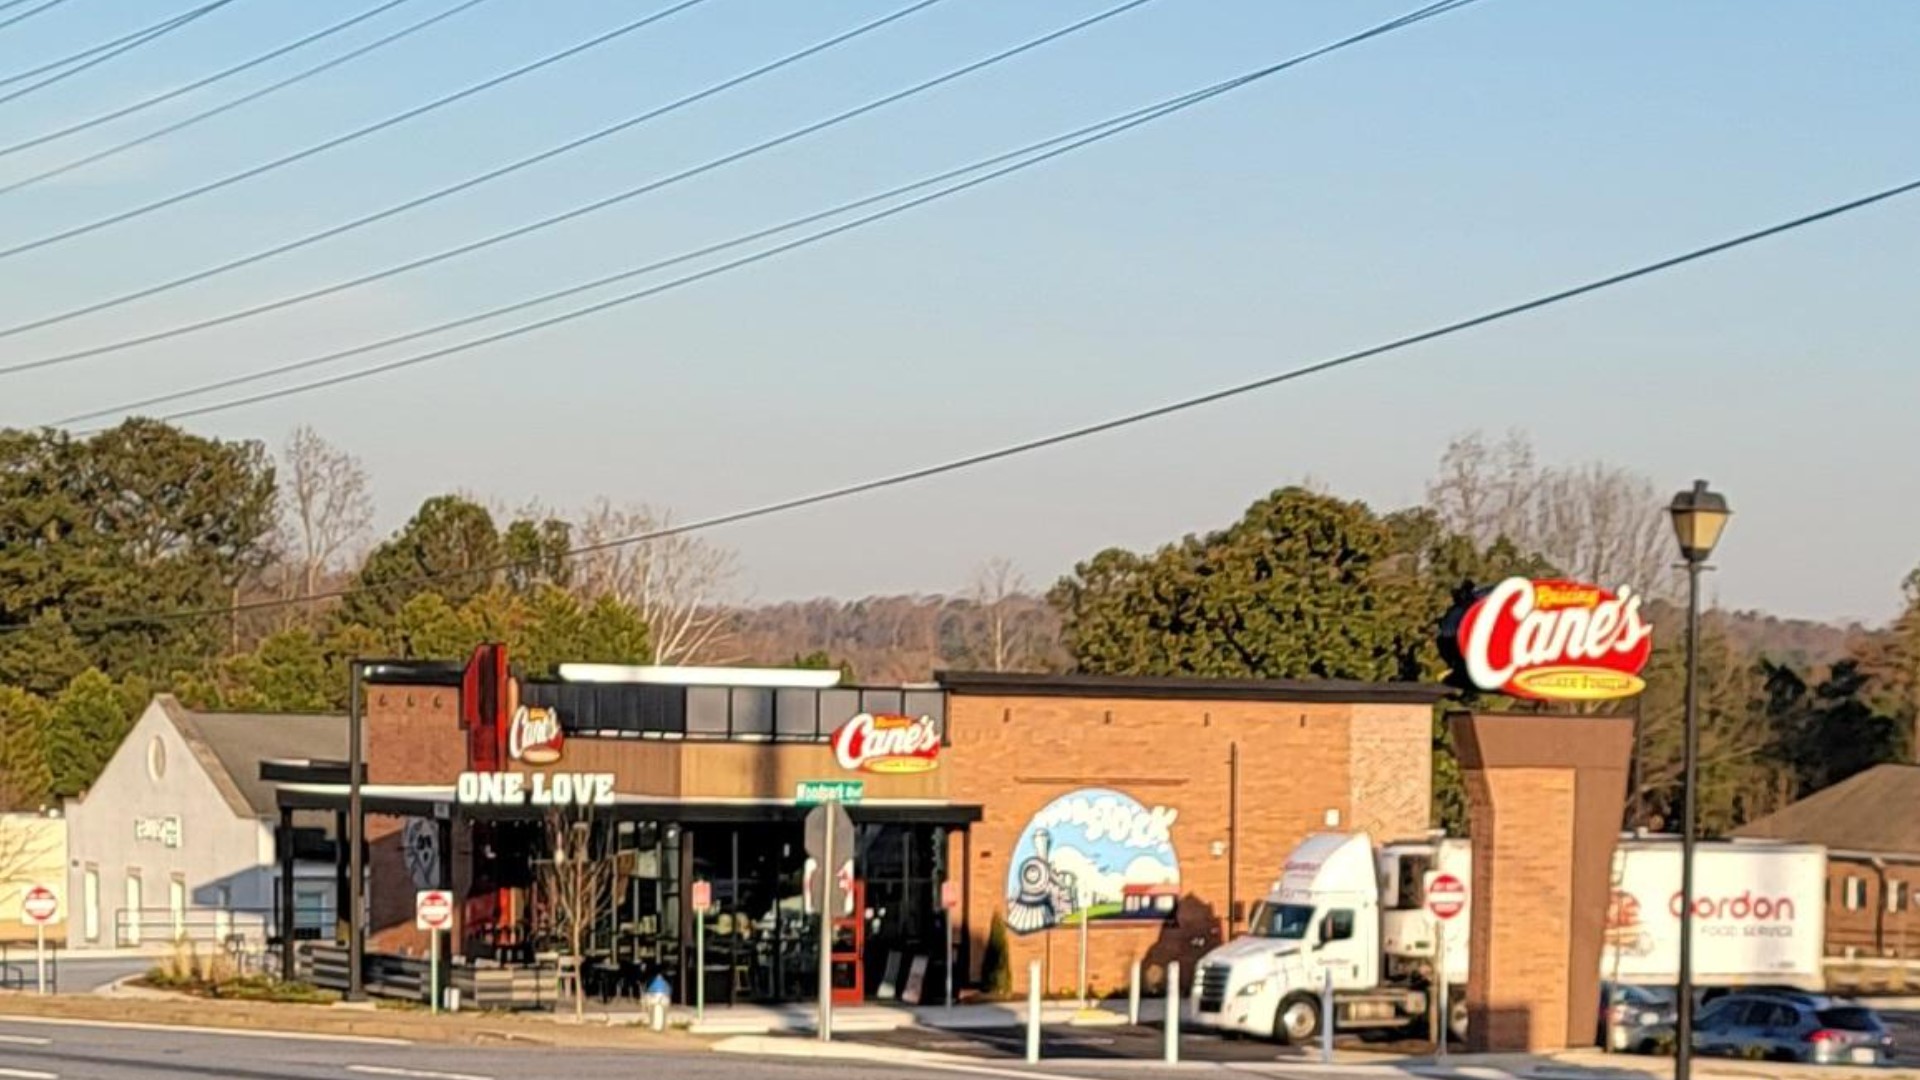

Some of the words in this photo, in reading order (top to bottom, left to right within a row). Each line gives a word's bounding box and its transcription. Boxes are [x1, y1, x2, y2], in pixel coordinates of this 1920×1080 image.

[1467, 576, 1653, 690] Cane's
[837, 713, 941, 769] Cane's
[457, 771, 525, 805] ONE
[530, 771, 616, 805] LOVE
